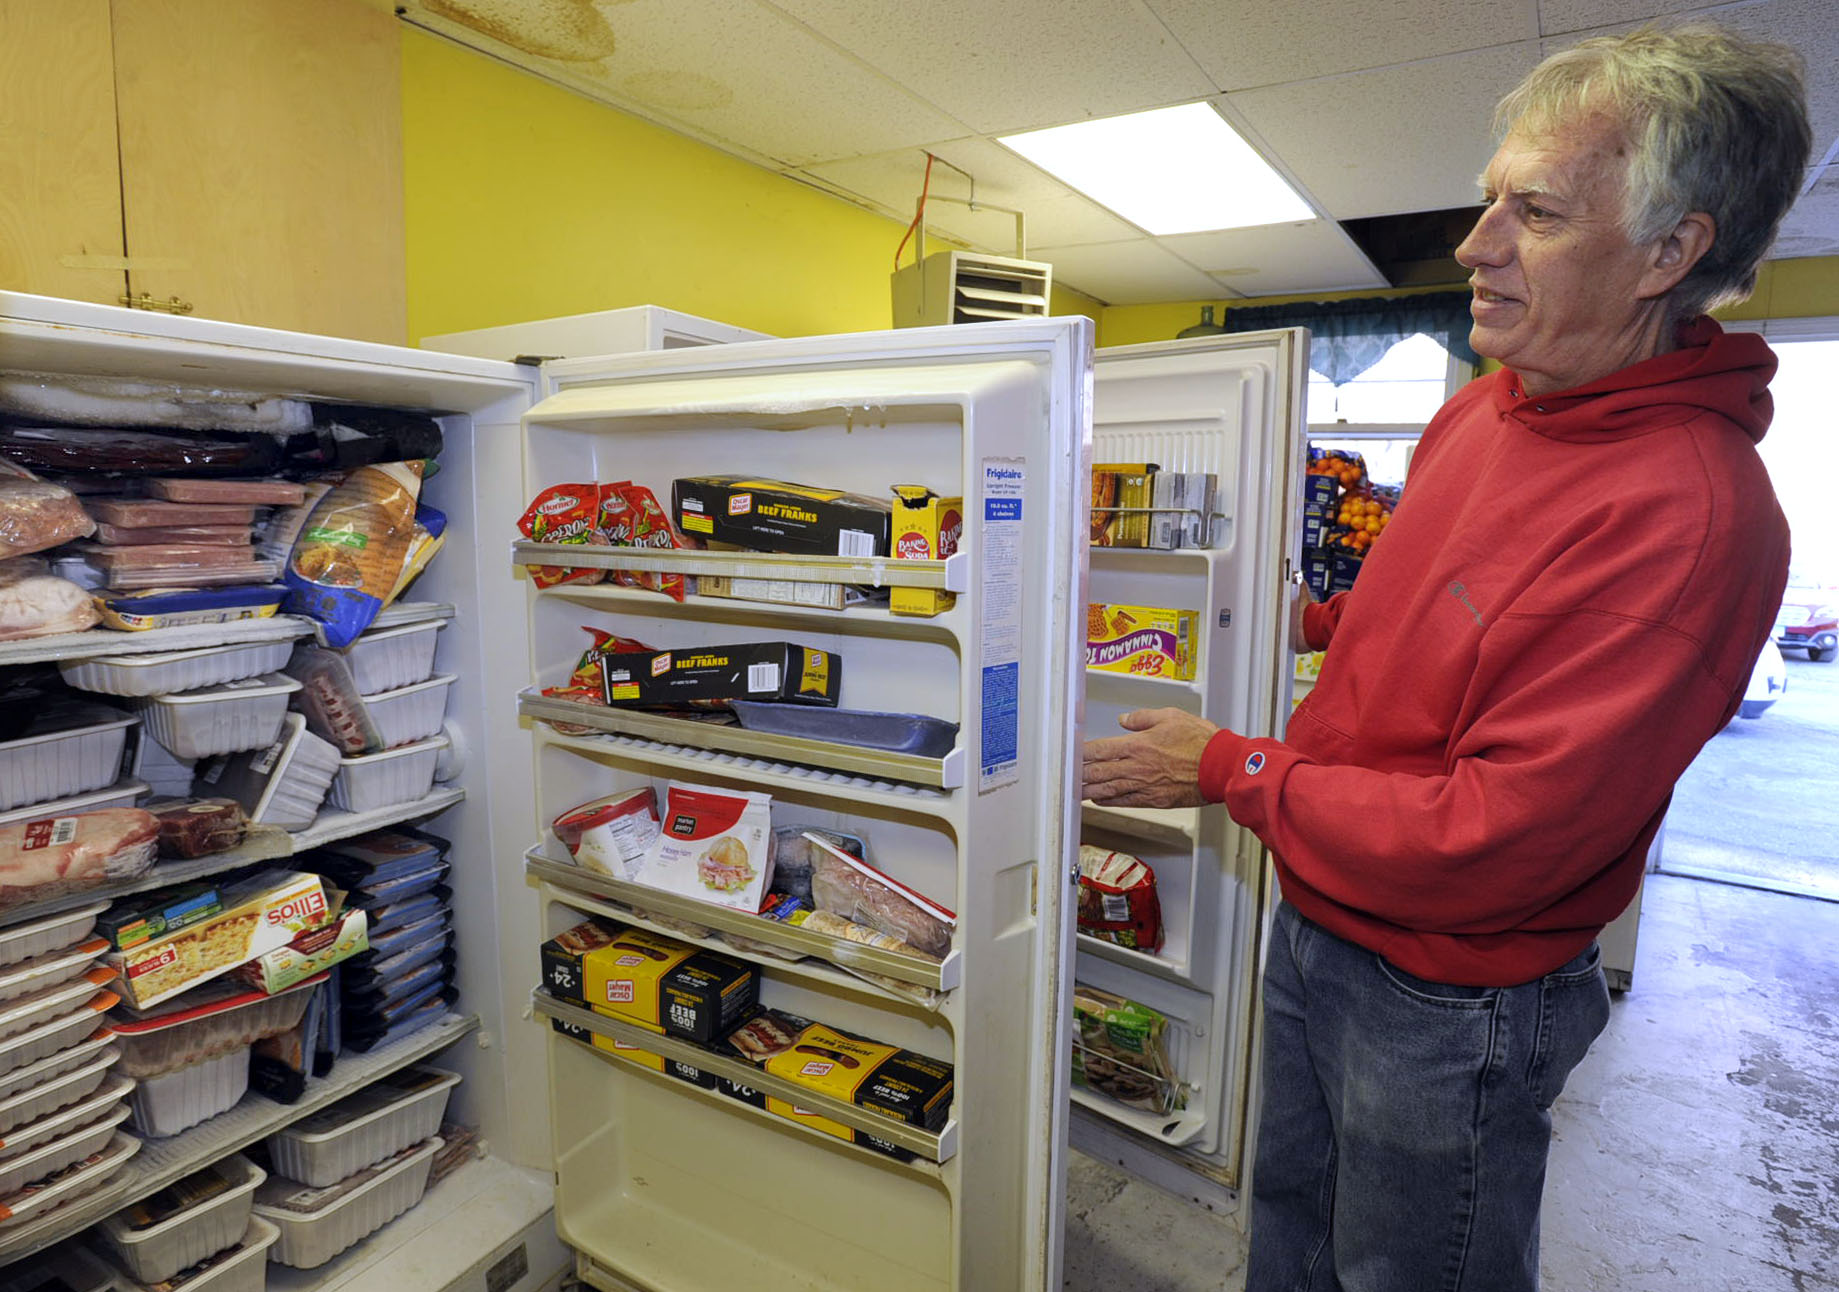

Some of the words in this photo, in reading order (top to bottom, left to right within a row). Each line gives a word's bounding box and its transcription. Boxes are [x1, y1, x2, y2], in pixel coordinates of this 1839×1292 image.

[987, 468, 1022, 480] Frigidaire
[757, 504, 779, 518] BEEF
[780, 506, 818, 523] FRANKS
[905, 551, 928, 560] SODA
[1100, 632, 1163, 662] CINNAMON
[676, 659, 696, 669] BEEF
[696, 657, 729, 668] FRANKS
[1129, 654, 1165, 676] Eggo
[267, 892, 325, 926] Ellio's
[554, 971, 572, 988] 24
[609, 992, 630, 1000] Oscar
[669, 1003, 696, 1020] BEEF
